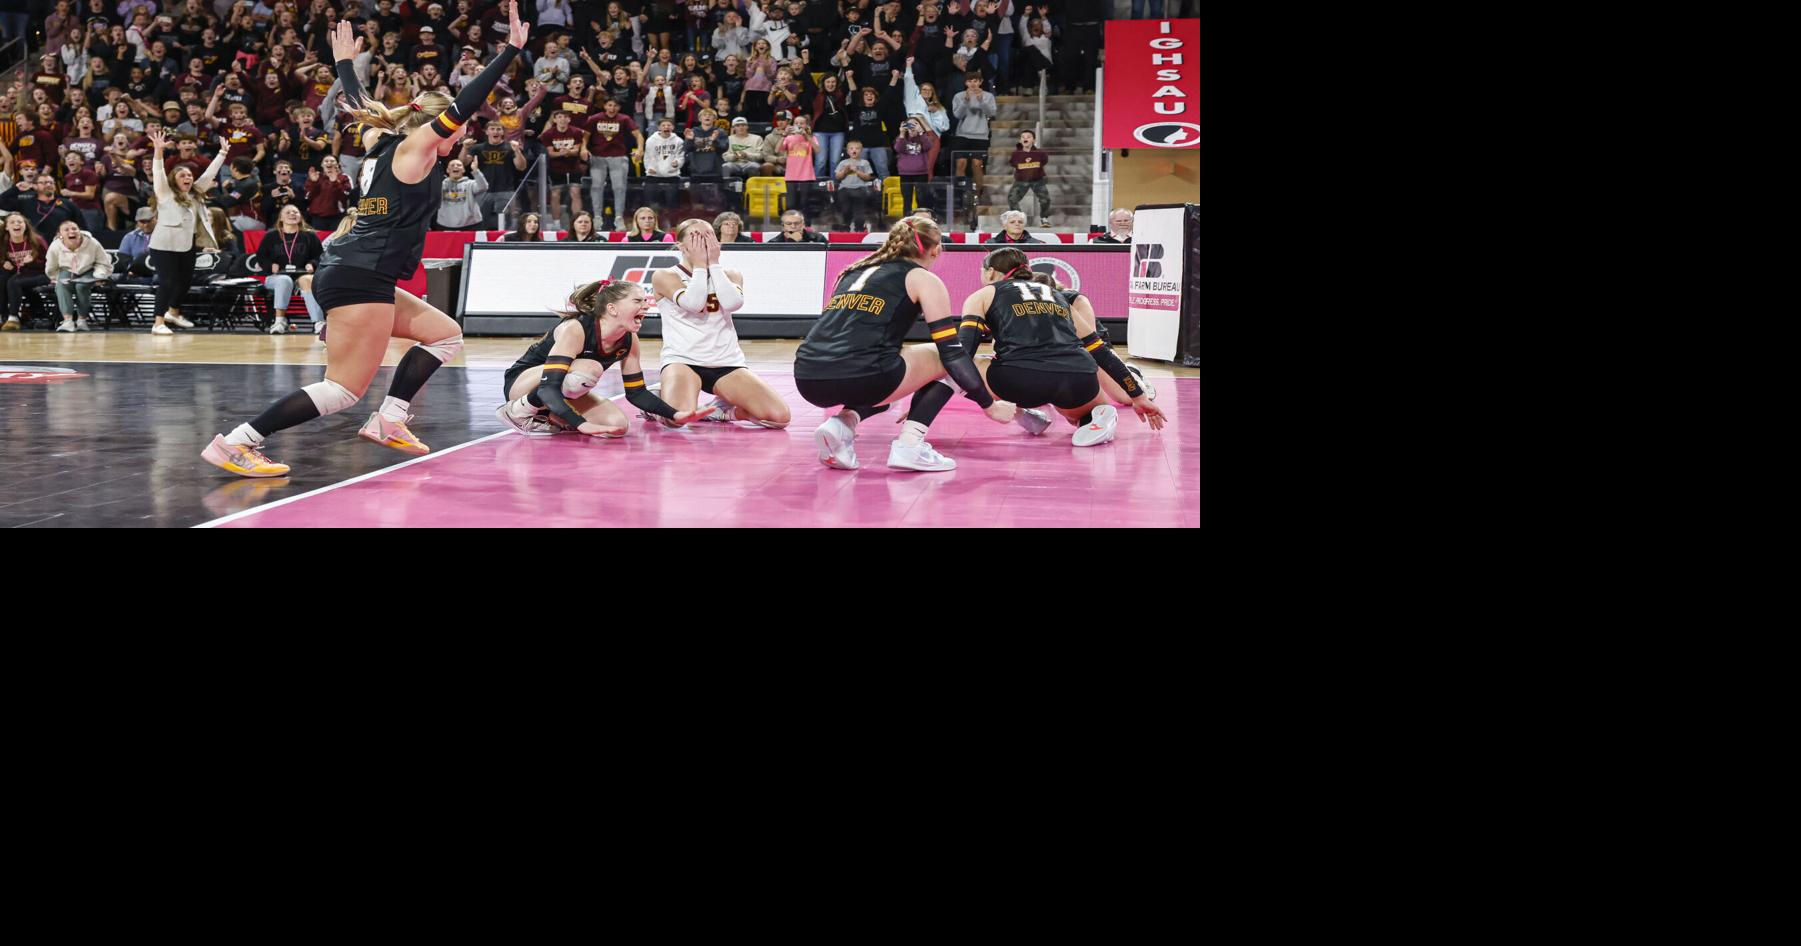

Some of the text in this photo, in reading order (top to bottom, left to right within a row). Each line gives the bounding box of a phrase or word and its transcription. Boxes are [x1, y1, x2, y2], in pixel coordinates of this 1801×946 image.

[1149, 21, 1187, 115] IGHSAU
[847, 265, 881, 292] 1
[1134, 281, 1151, 291] FARM
[1152, 281, 1180, 292] BUREAU
[1012, 281, 1056, 303] 17
[826, 293, 886, 315] ENVER
